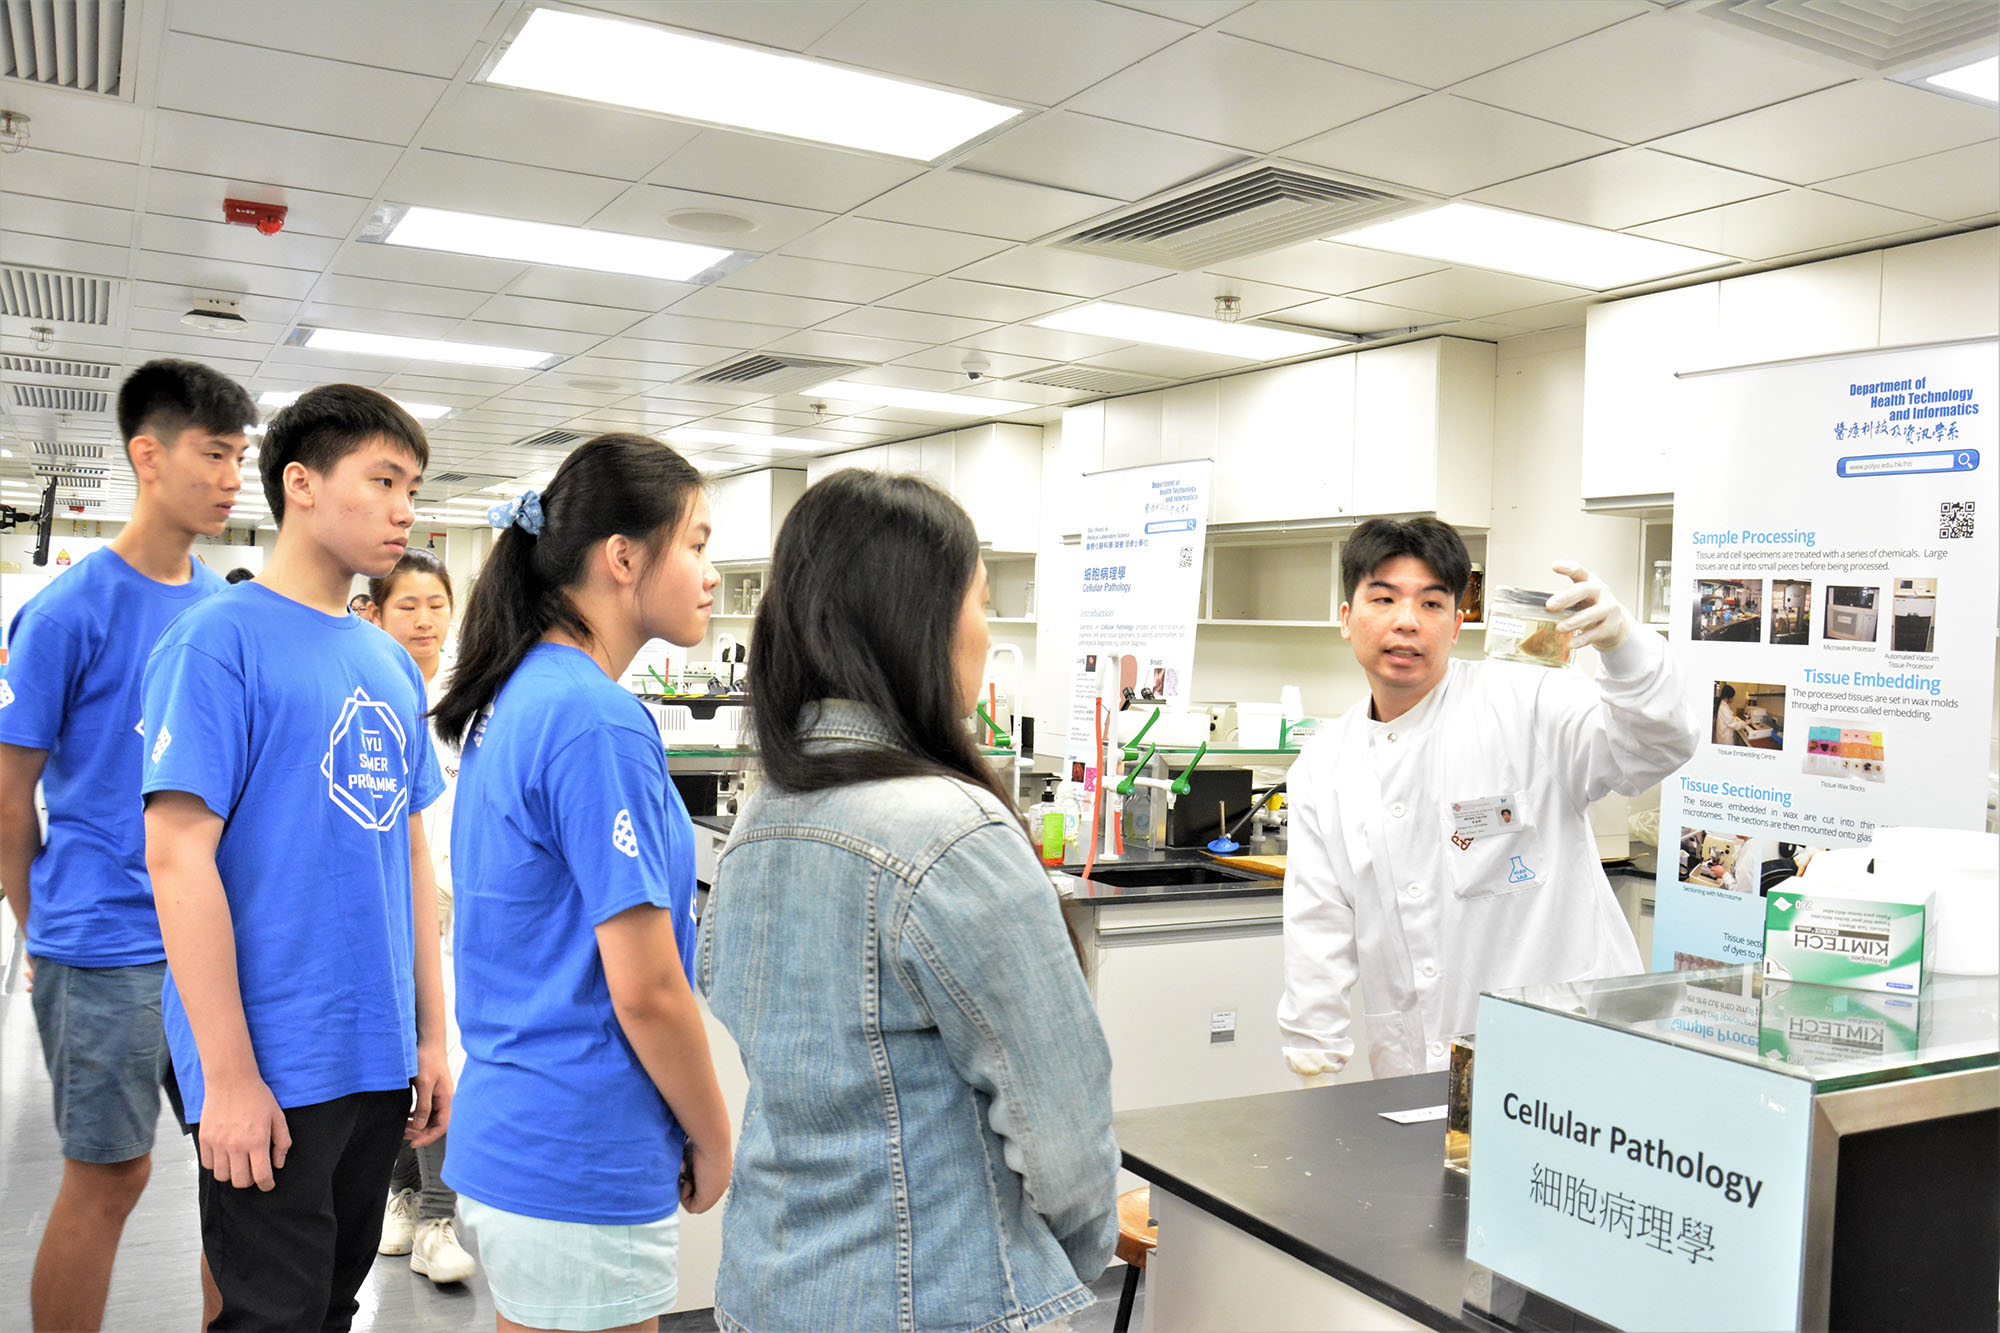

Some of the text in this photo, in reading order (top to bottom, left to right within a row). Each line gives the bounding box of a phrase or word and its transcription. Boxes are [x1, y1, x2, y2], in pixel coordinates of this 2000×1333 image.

[1850, 377, 1926, 396] Department of
[1871, 389, 1973, 408] Health Technology
[1889, 403, 1979, 421] and Informatics
[1692, 529, 1816, 548] Sample Processing
[1696, 551, 1715, 559] Tissue
[1716, 550, 1729, 559] and
[1730, 550, 1742, 559] cell
[1743, 550, 1781, 561] specimens
[1794, 550, 1821, 558] treated
[1823, 550, 1839, 558] with
[1846, 550, 1868, 558] series
[1869, 549, 1877, 558] of
[1878, 549, 1920, 558] chemicals.
[1924, 549, 1948, 560] Large
[1696, 562, 1716, 571] tissues
[1742, 562, 1757, 570] into
[1758, 562, 1777, 570] small
[1778, 562, 1799, 572] pieces
[1801, 561, 1826, 570] before
[1828, 562, 1848, 573] being
[1850, 562, 1890, 573] processed.
[1104, 582, 1131, 593] Pathology
[1804, 669, 1941, 695] Tissue Embedding
[1792, 688, 1806, 697] The
[1807, 689, 1847, 702] processed
[1848, 692, 1873, 703] tissues
[1889, 696, 1901, 704] set
[1902, 696, 1910, 705] in
[1930, 698, 1959, 708] molds
[1791, 701, 1822, 712] through
[1829, 703, 1859, 715] process
[1860, 705, 1882, 715] called
[1883, 708, 1932, 721] embedding.
[1680, 777, 1792, 807] Tissue Sectioning
[1683, 796, 1695, 805] The
[1699, 798, 1723, 809] tissues
[1728, 801, 1766, 815] embedded
[1771, 807, 1778, 816] in
[1783, 811, 1798, 819] wax
[1804, 812, 1817, 822] are
[1822, 814, 1834, 824] cut
[1840, 816, 1855, 828] into
[1860, 818, 1875, 829] thin
[1682, 808, 1872, 843] microtomes. The sections are then mounted onto glas
[1723, 932, 1745, 945] Tissue
[1794, 934, 1889, 956] KIMTECH
[1722, 944, 1730, 952] of
[1731, 946, 1747, 956] dyes
[1748, 950, 1755, 958] to
[1503, 1092, 1763, 1208] Cellular Pathology
[1529, 1162, 1716, 1265] 細胞病理學
